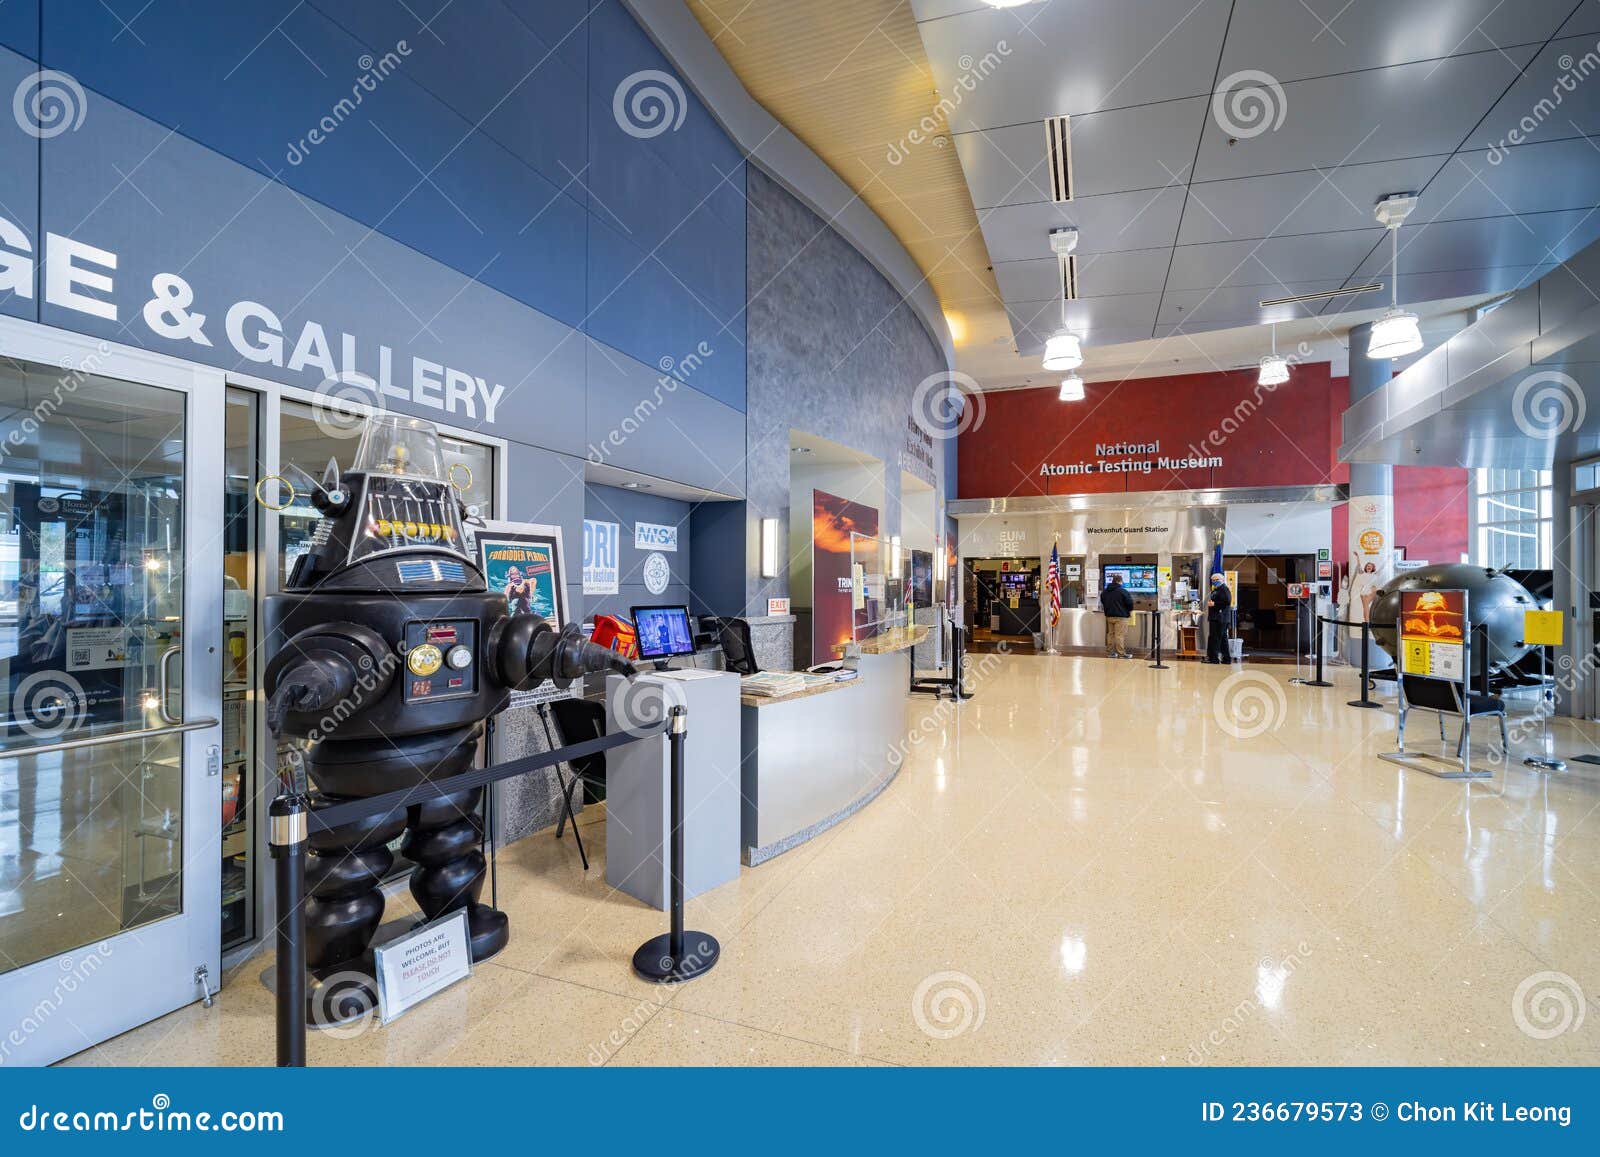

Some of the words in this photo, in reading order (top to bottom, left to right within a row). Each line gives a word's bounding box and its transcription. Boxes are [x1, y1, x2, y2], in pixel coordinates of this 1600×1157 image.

[143, 273, 214, 347] &
[225, 300, 505, 424] GALLERY
[1095, 440, 1160, 457] National
[1040, 461, 1093, 476] Atomic
[1099, 457, 1152, 474] Testing
[1158, 455, 1223, 470] Museum
[1087, 526, 1122, 534] Wackenhut
[1123, 526, 1144, 534] Guard
[770, 599, 787, 609] EXIT
[401, 947, 437, 968] WELCOME,
[438, 940, 450, 951] BUT
[405, 939, 433, 956] PHOTOS
[433, 933, 445, 944] ARE
